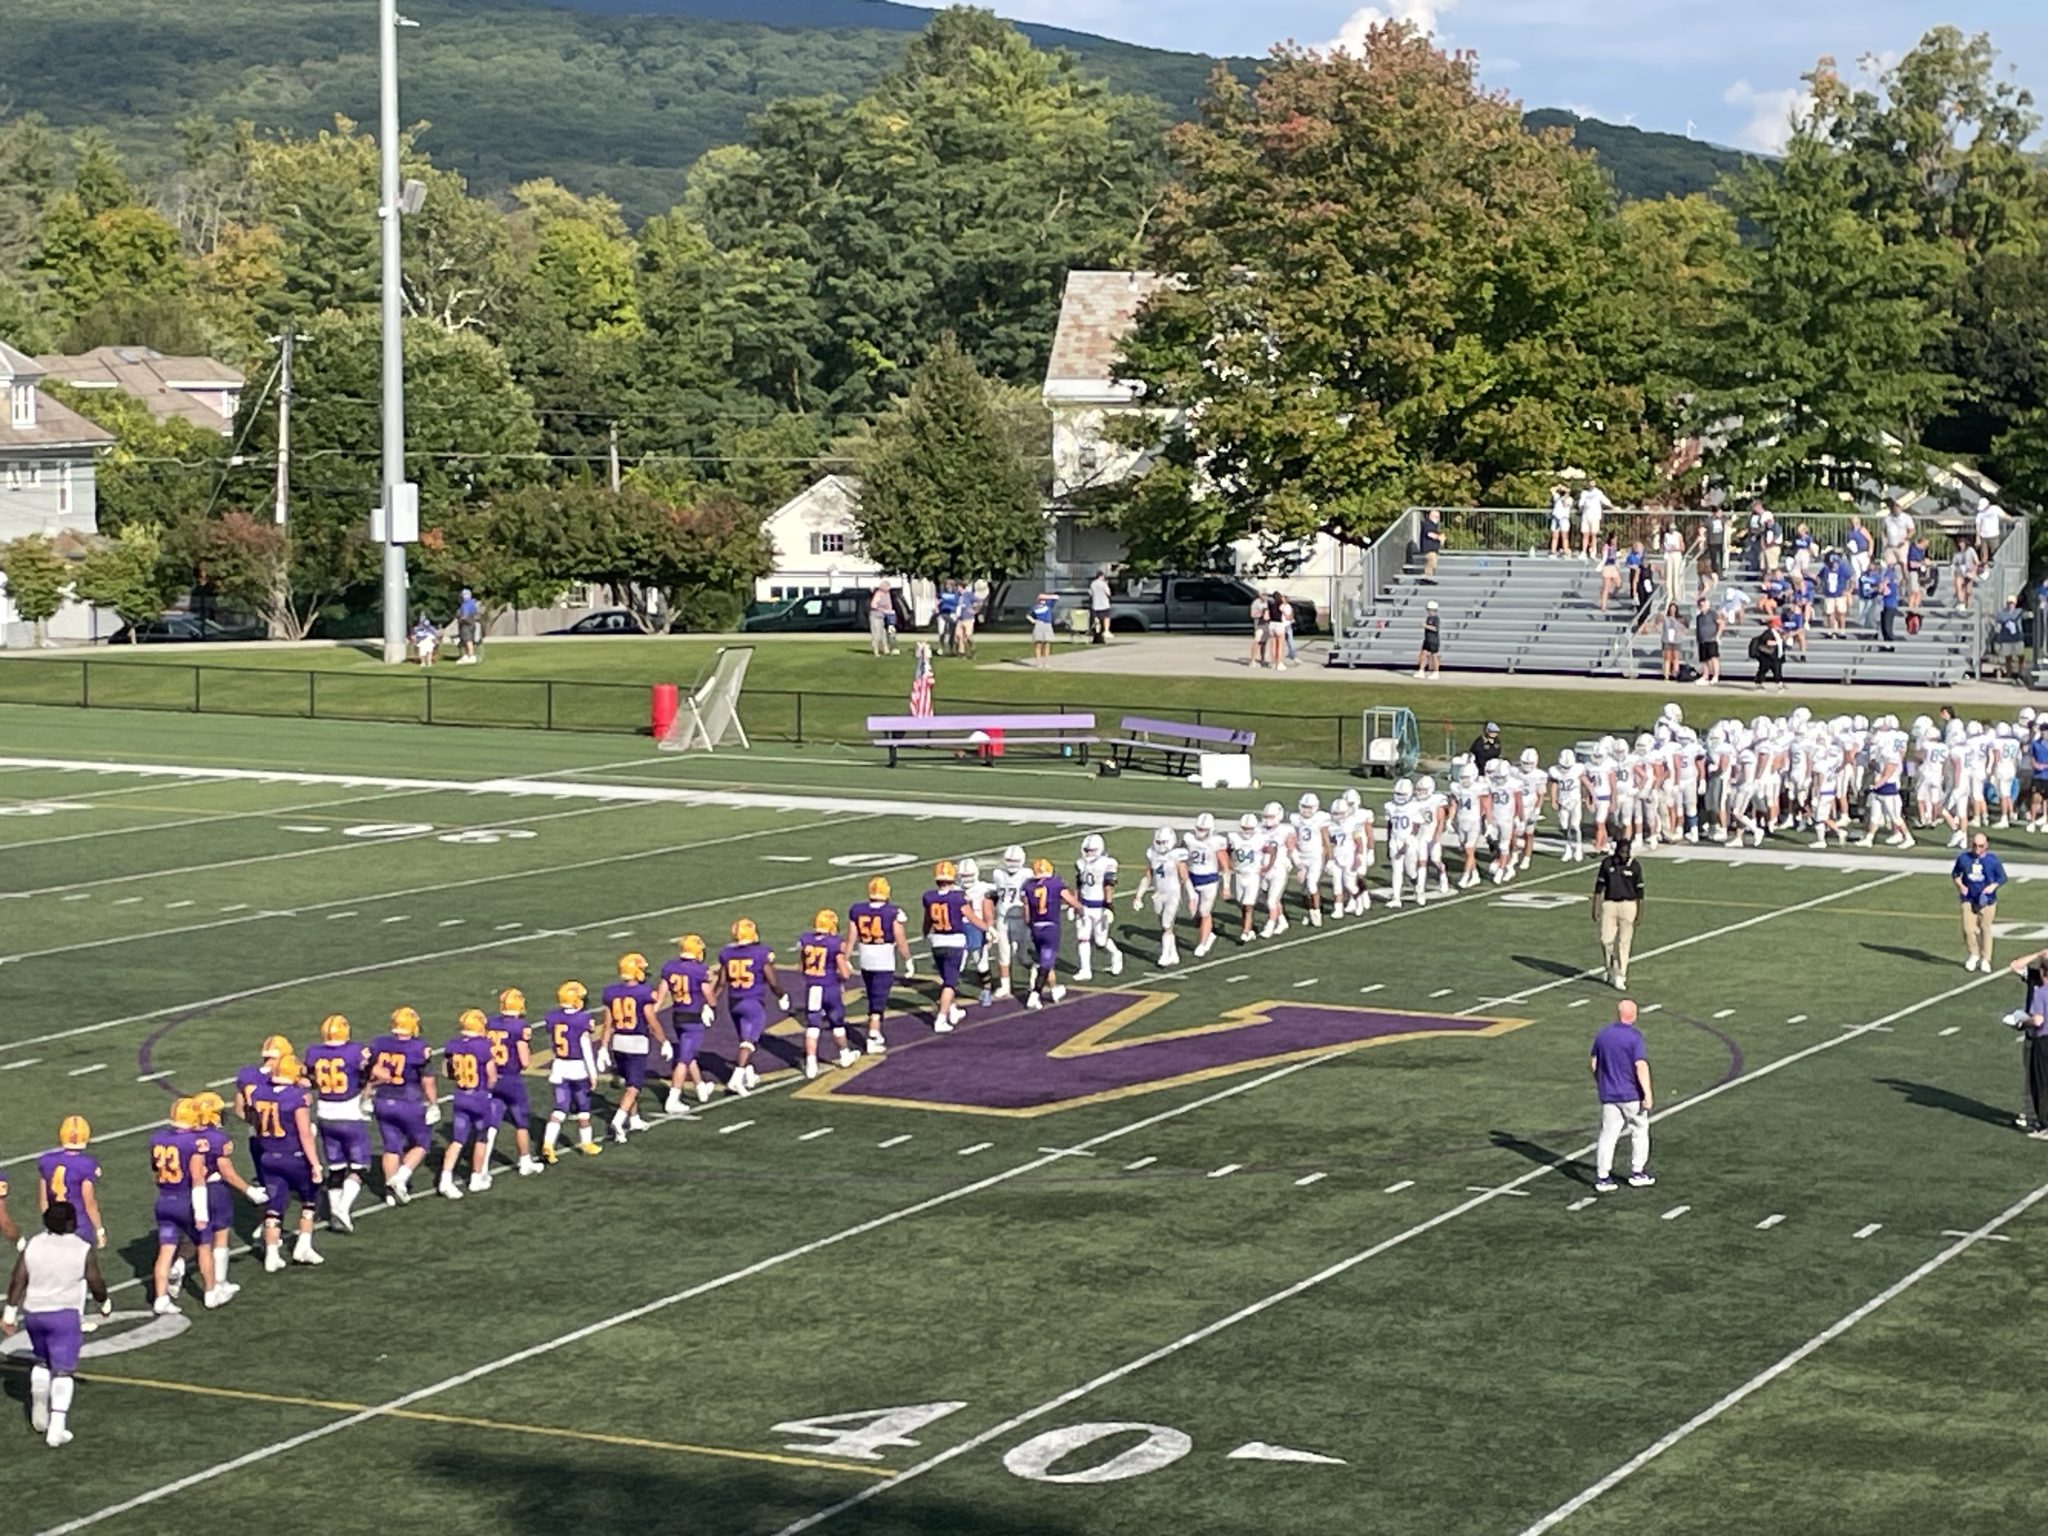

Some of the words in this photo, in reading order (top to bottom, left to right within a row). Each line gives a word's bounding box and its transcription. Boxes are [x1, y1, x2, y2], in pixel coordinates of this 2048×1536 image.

[931, 902, 952, 931] 91
[1034, 885, 1048, 915] 7
[857, 915, 885, 944] 54
[728, 959, 755, 989] 95
[804, 945, 828, 977] 27
[612, 996, 637, 1030] 49
[554, 1024, 569, 1058] 5
[315, 1057, 348, 1094] 66
[255, 1100, 286, 1137] 71
[51, 1165, 68, 1202] 4
